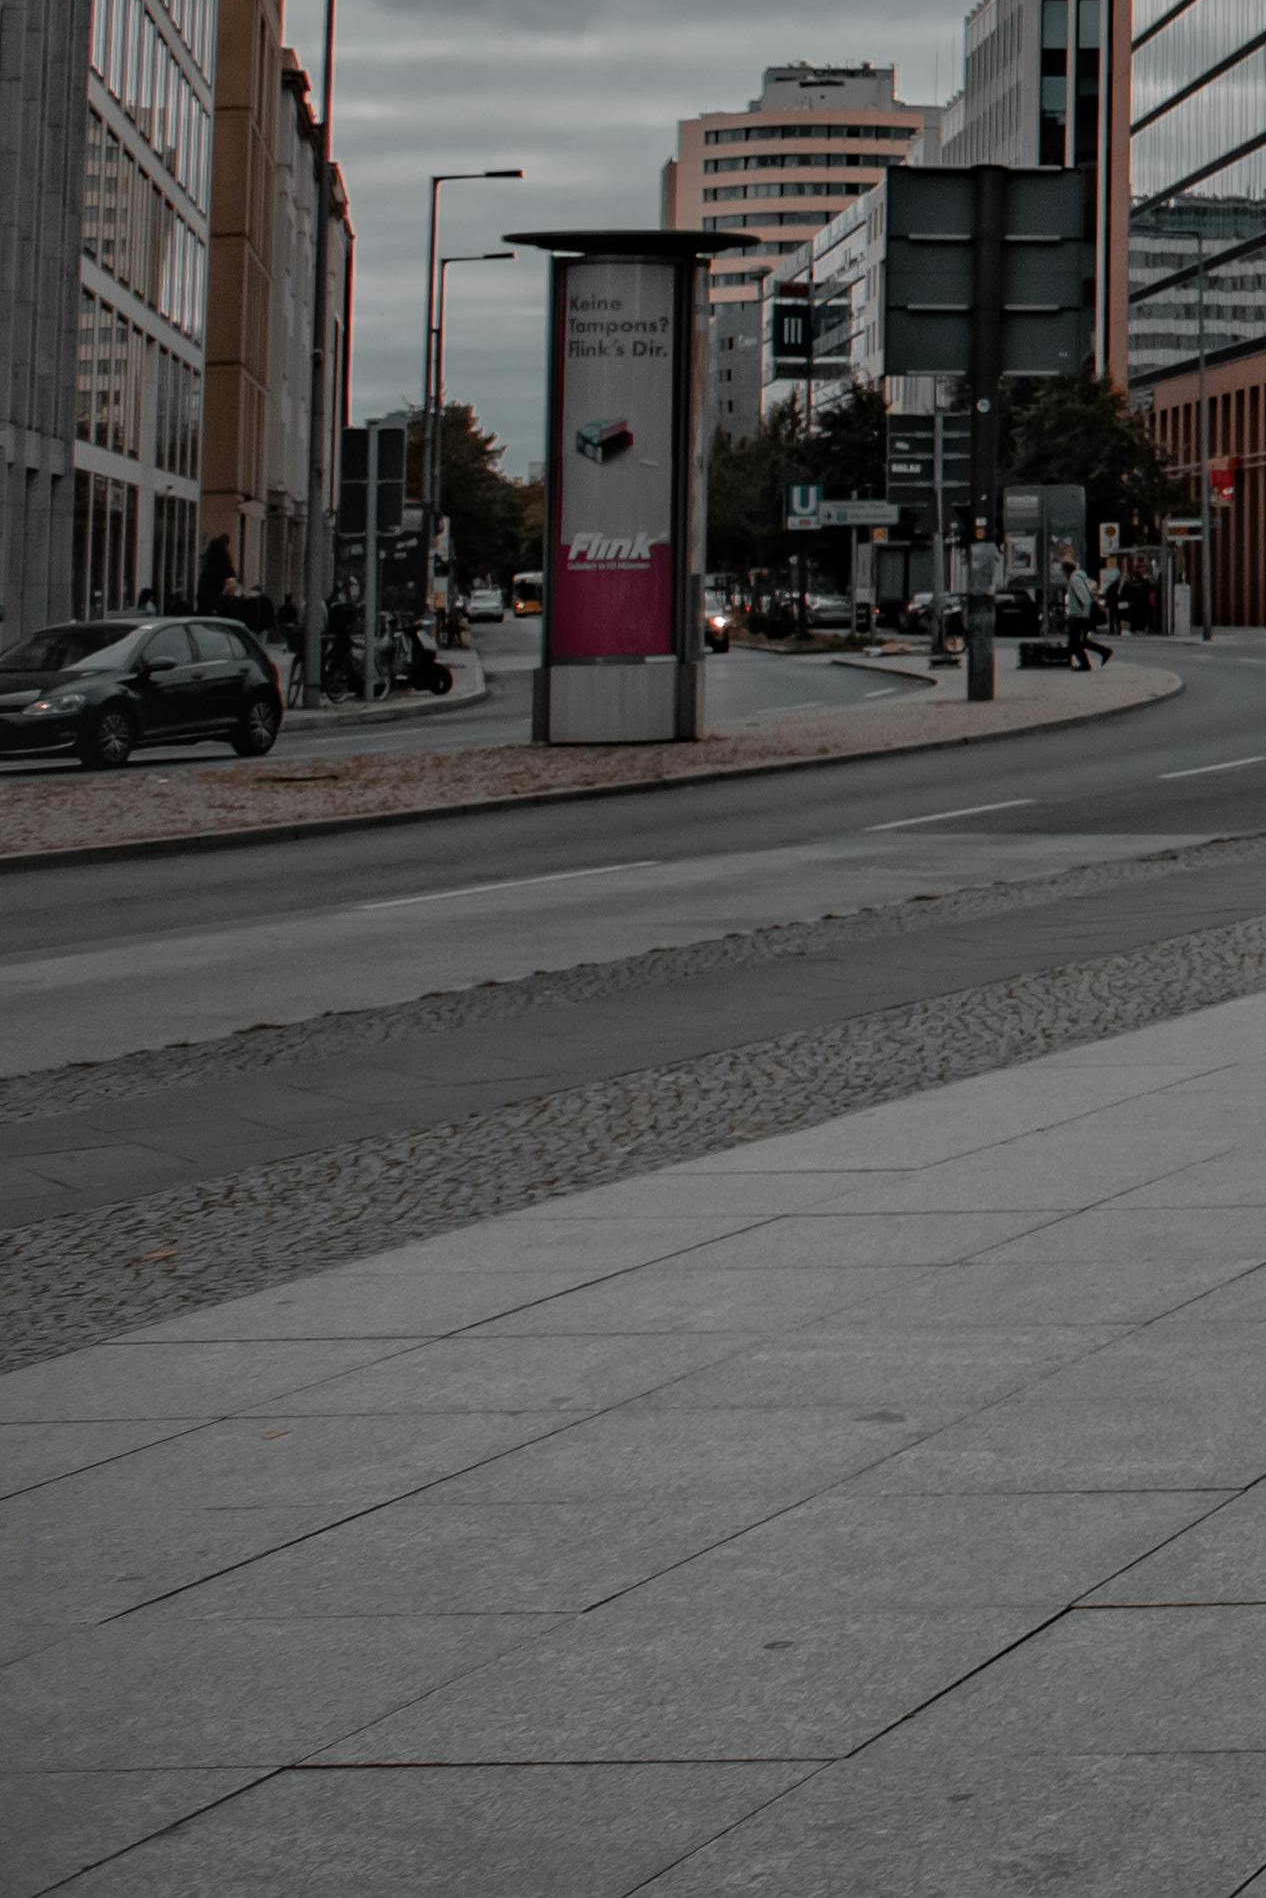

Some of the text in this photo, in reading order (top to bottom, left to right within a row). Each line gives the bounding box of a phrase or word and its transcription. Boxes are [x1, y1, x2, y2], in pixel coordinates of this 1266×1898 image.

[570, 293, 622, 311] Keine
[569, 316, 669, 337] Tampons?
[632, 340, 669, 357] Dir.
[791, 484, 818, 515] U
[567, 531, 653, 561] Flink
